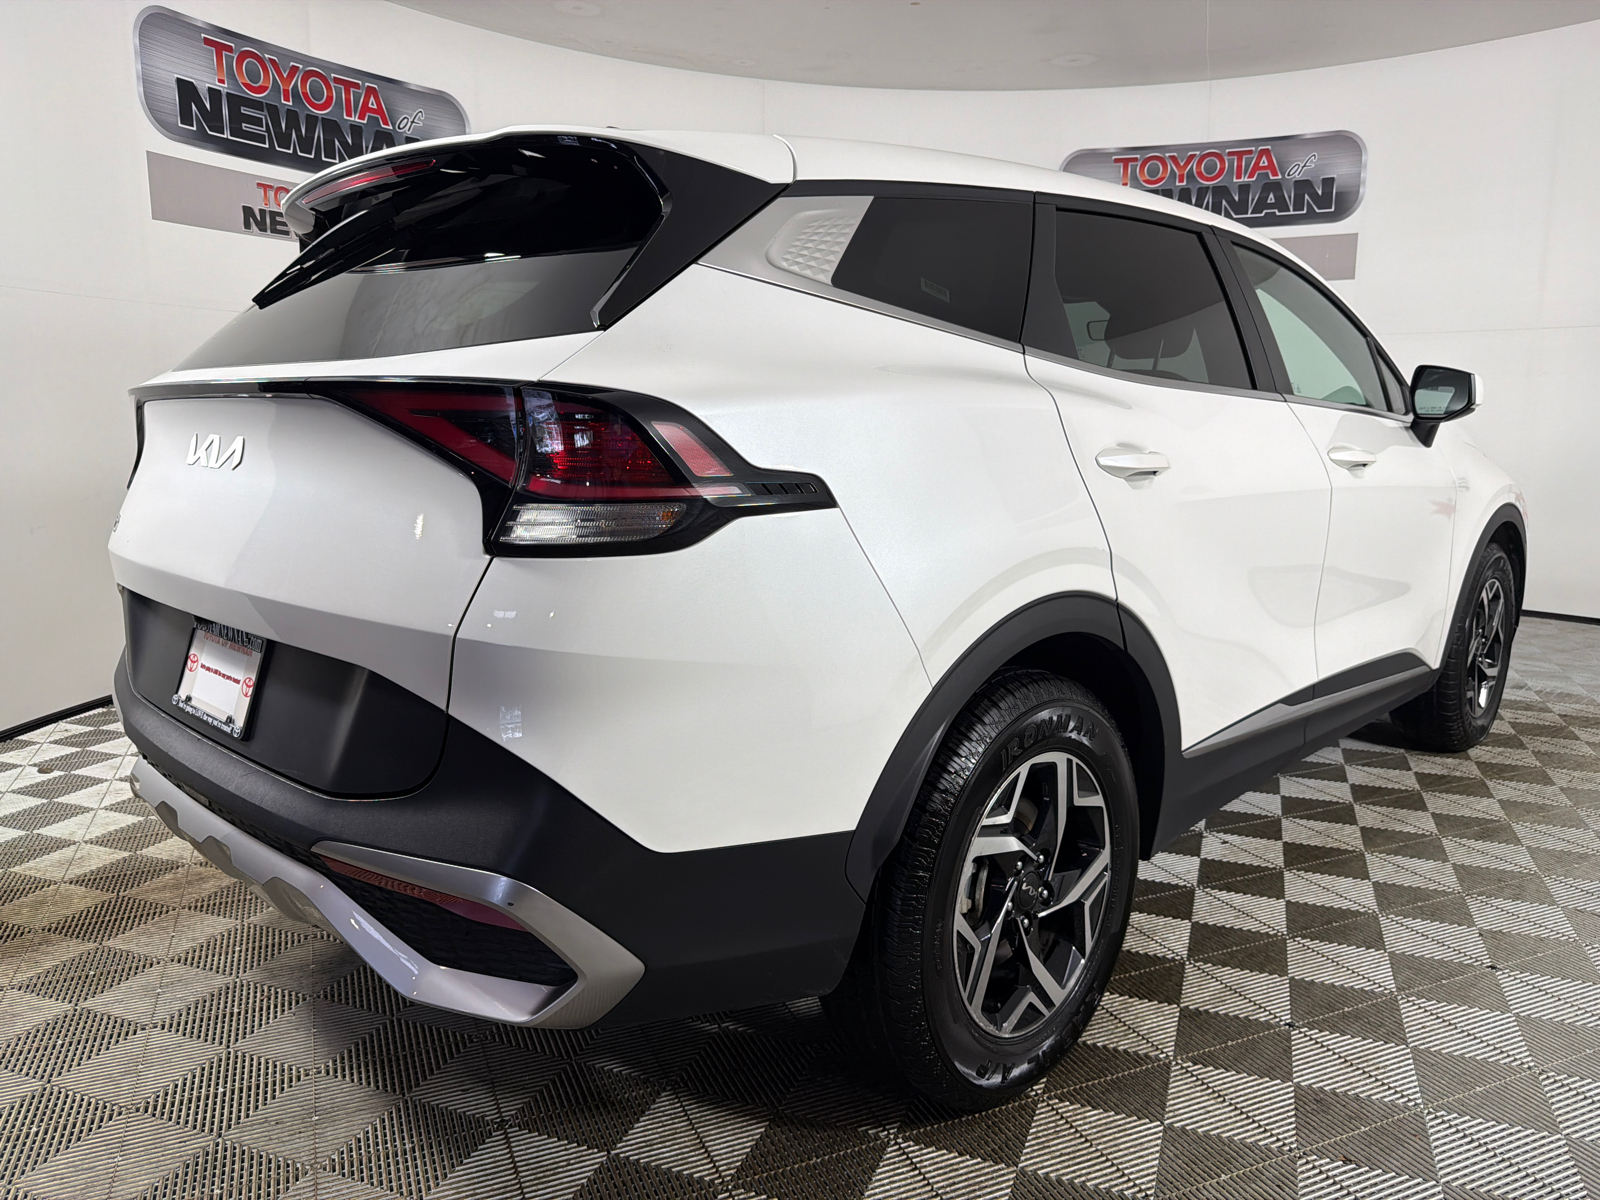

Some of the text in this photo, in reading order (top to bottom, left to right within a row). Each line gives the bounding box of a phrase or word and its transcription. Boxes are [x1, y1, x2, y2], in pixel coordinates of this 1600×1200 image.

[202, 34, 425, 134] TOYOTA of
[1112, 146, 1318, 187] TOYOTA of
[186, 432, 246, 471] KIA
[1000, 713, 1099, 773] IRONMAN
